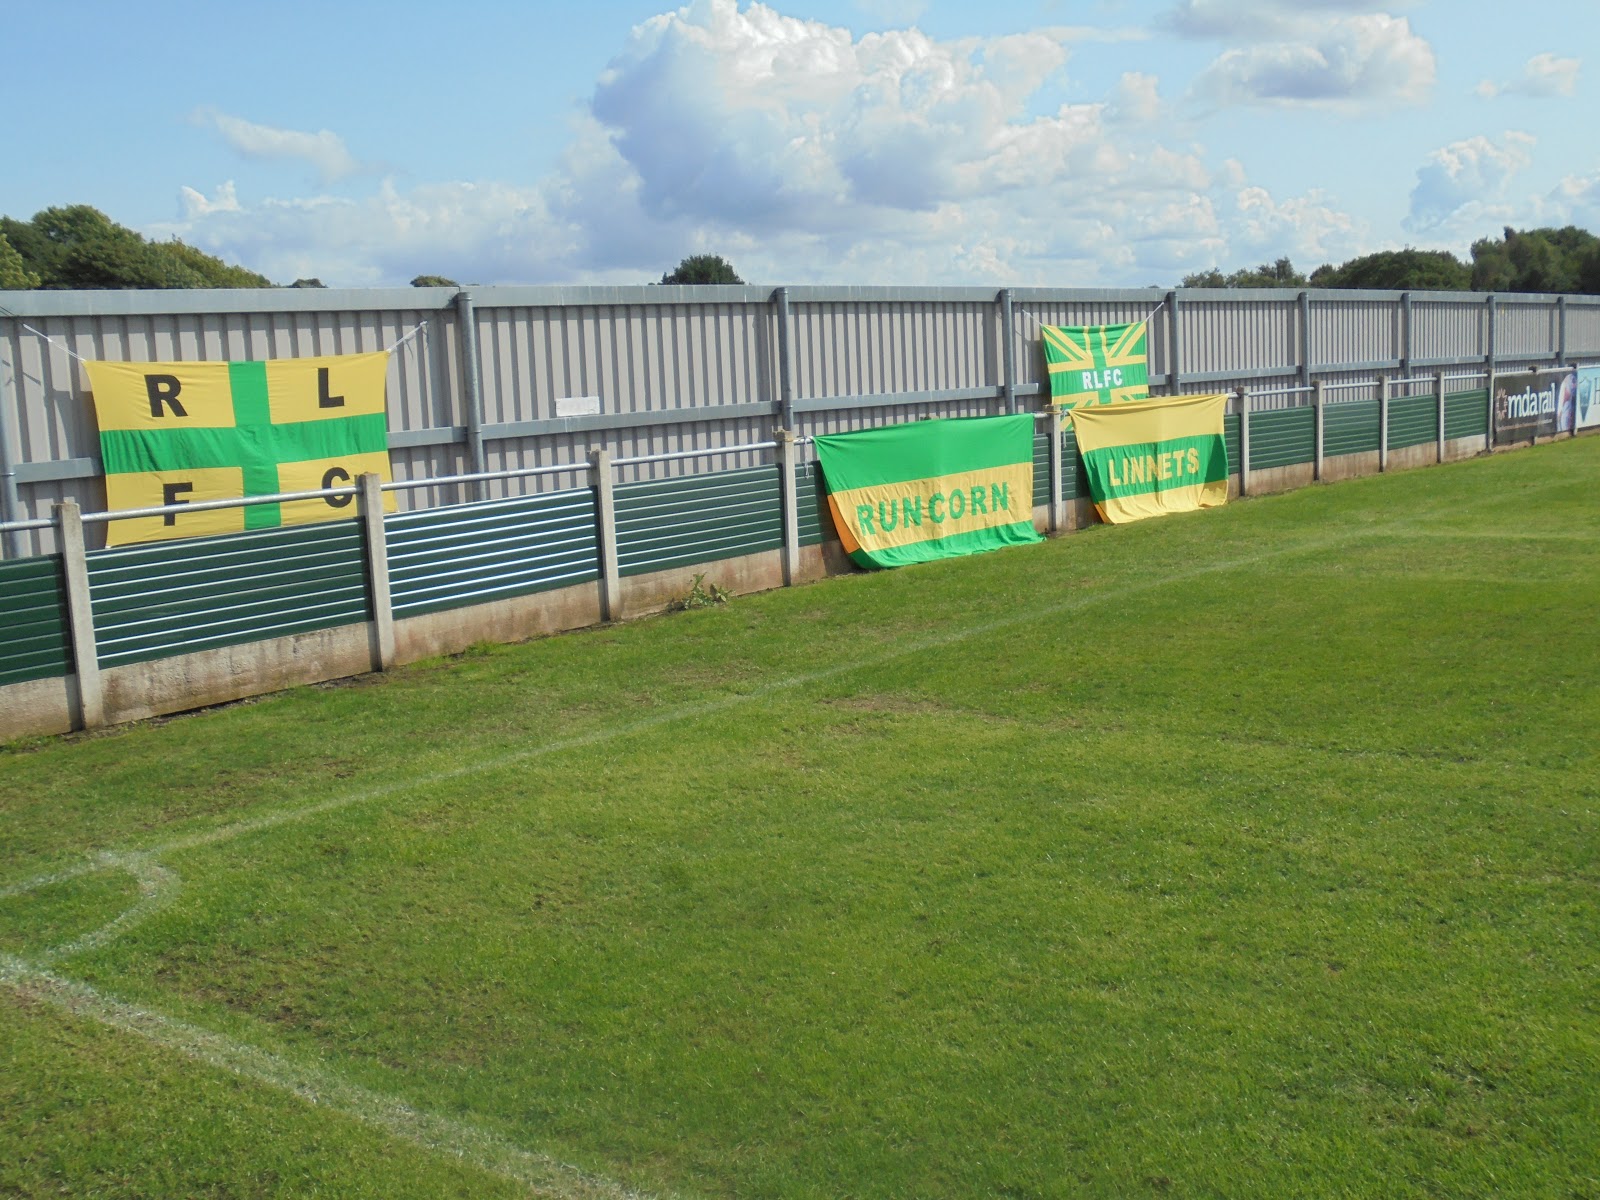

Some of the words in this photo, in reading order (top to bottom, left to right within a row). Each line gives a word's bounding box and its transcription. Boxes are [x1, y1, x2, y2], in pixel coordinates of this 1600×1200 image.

[144, 374, 188, 418] R
[317, 367, 345, 409] L
[1082, 368, 1123, 389] RLFC
[1108, 447, 1199, 487] LINNETS
[163, 482, 193, 526] F
[321, 467, 354, 508] C
[855, 481, 1009, 537] RUNCORN
